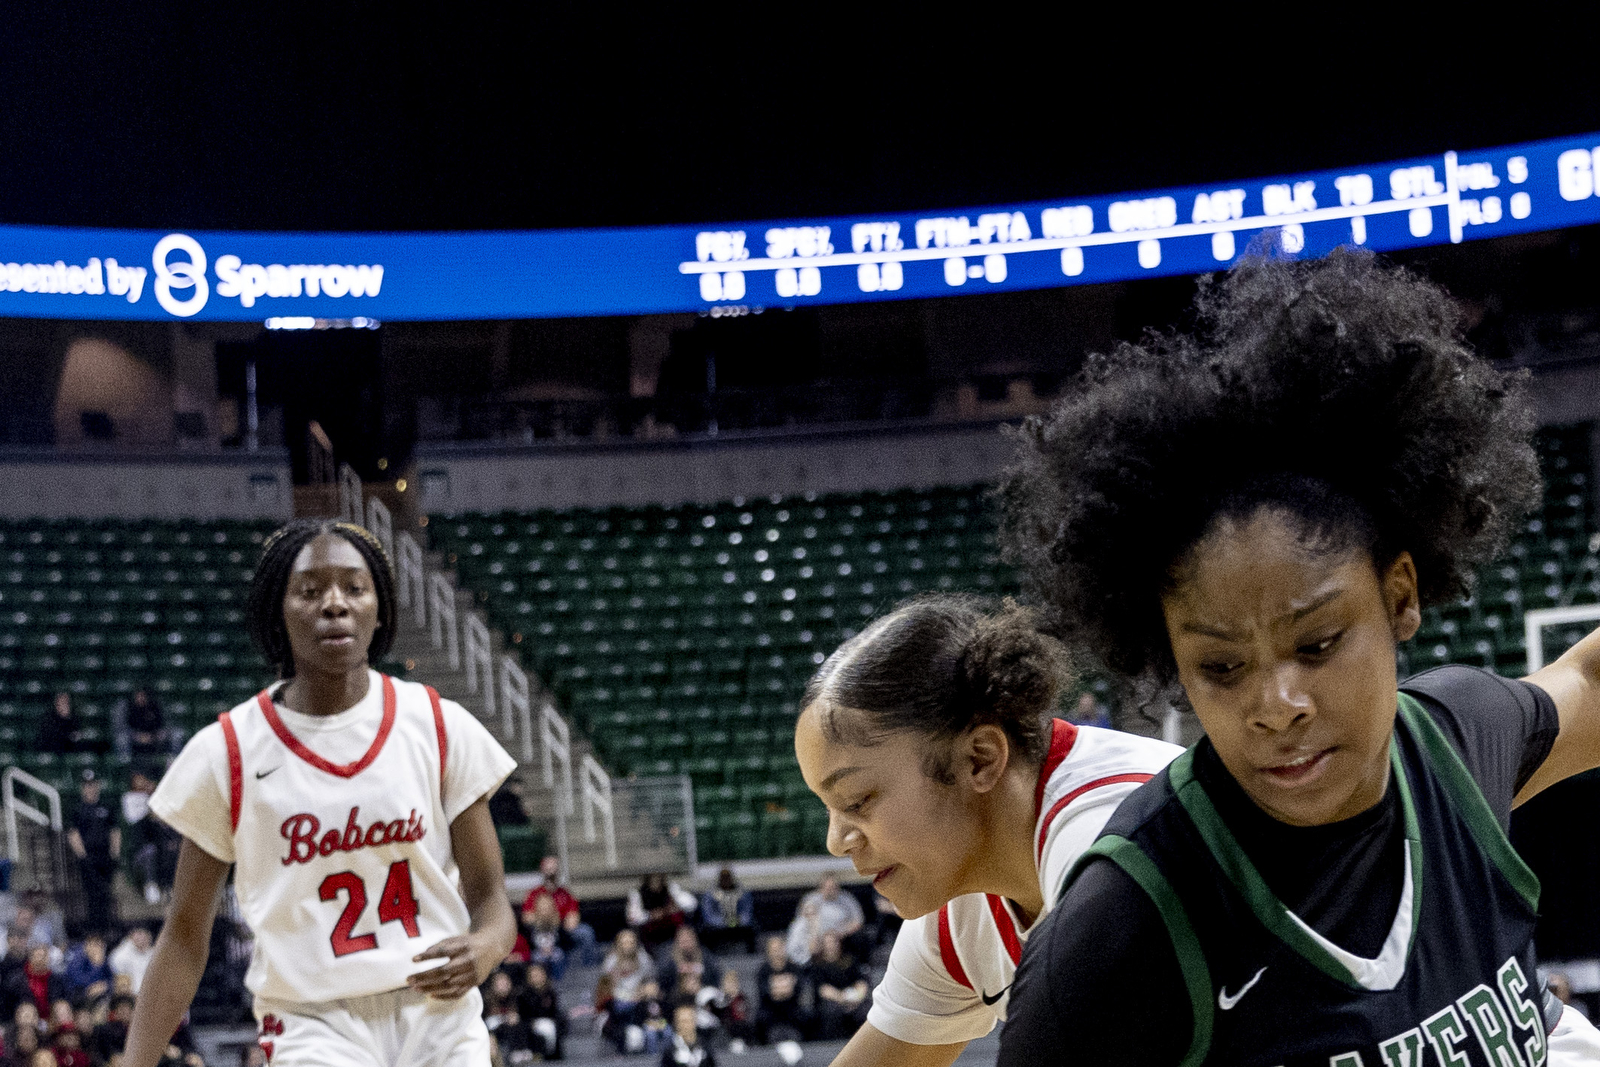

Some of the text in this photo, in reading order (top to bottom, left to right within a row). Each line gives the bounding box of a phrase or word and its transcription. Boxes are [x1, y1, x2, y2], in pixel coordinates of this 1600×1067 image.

[104, 257, 147, 304] by
[215, 254, 384, 307] Sparrow
[281, 806, 426, 866] Bobcats
[318, 859, 420, 958] 24
